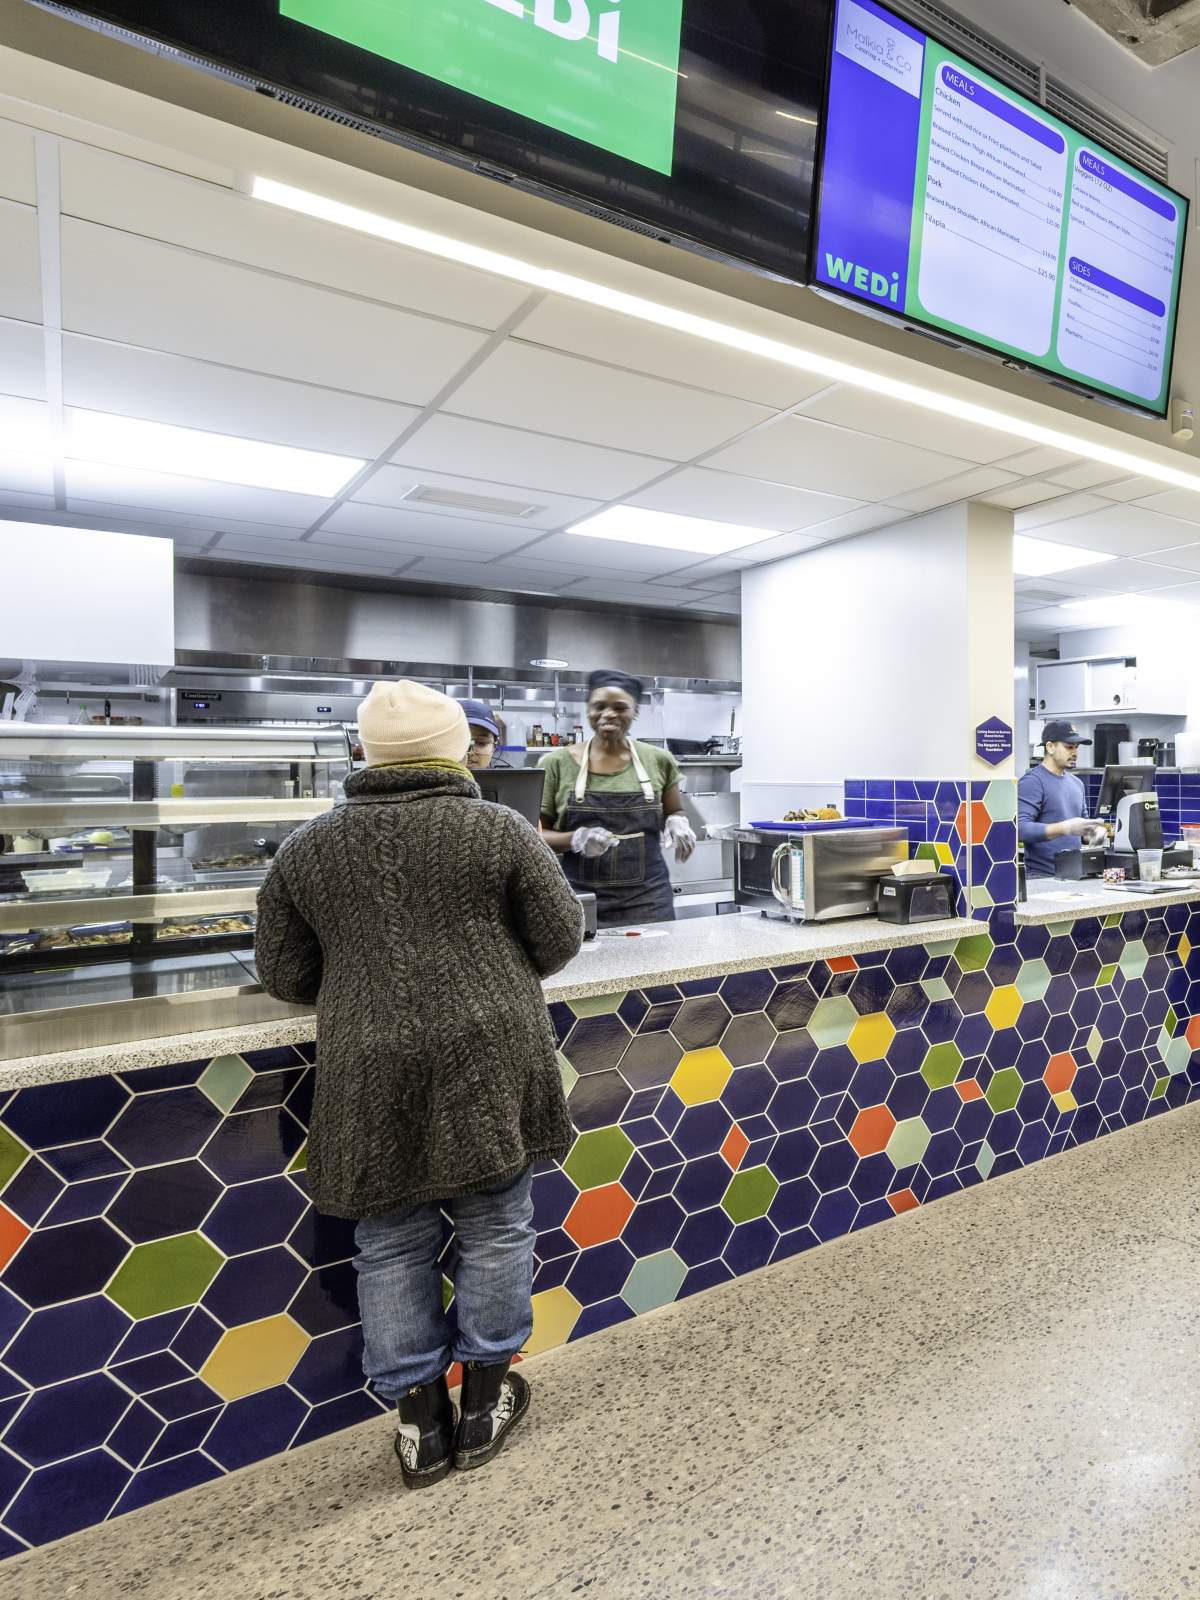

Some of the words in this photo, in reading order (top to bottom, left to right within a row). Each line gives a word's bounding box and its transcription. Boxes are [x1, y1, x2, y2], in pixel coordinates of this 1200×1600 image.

[484, 0, 620, 63] Di
[945, 71, 975, 97] MEALS
[935, 86, 961, 108] Chicken
[951, 132, 971, 149] Chicken
[985, 151, 1002, 166] African
[949, 148, 969, 165] Chicken
[985, 168, 1002, 182] African
[1082, 155, 1105, 176] MEALS
[927, 175, 942, 189] Pork
[959, 171, 978, 187] Chicken
[979, 181, 995, 196] African
[925, 212, 945, 231] Tilapia
[826, 253, 899, 302] WEDi
[1072, 261, 1091, 278] SIDES
